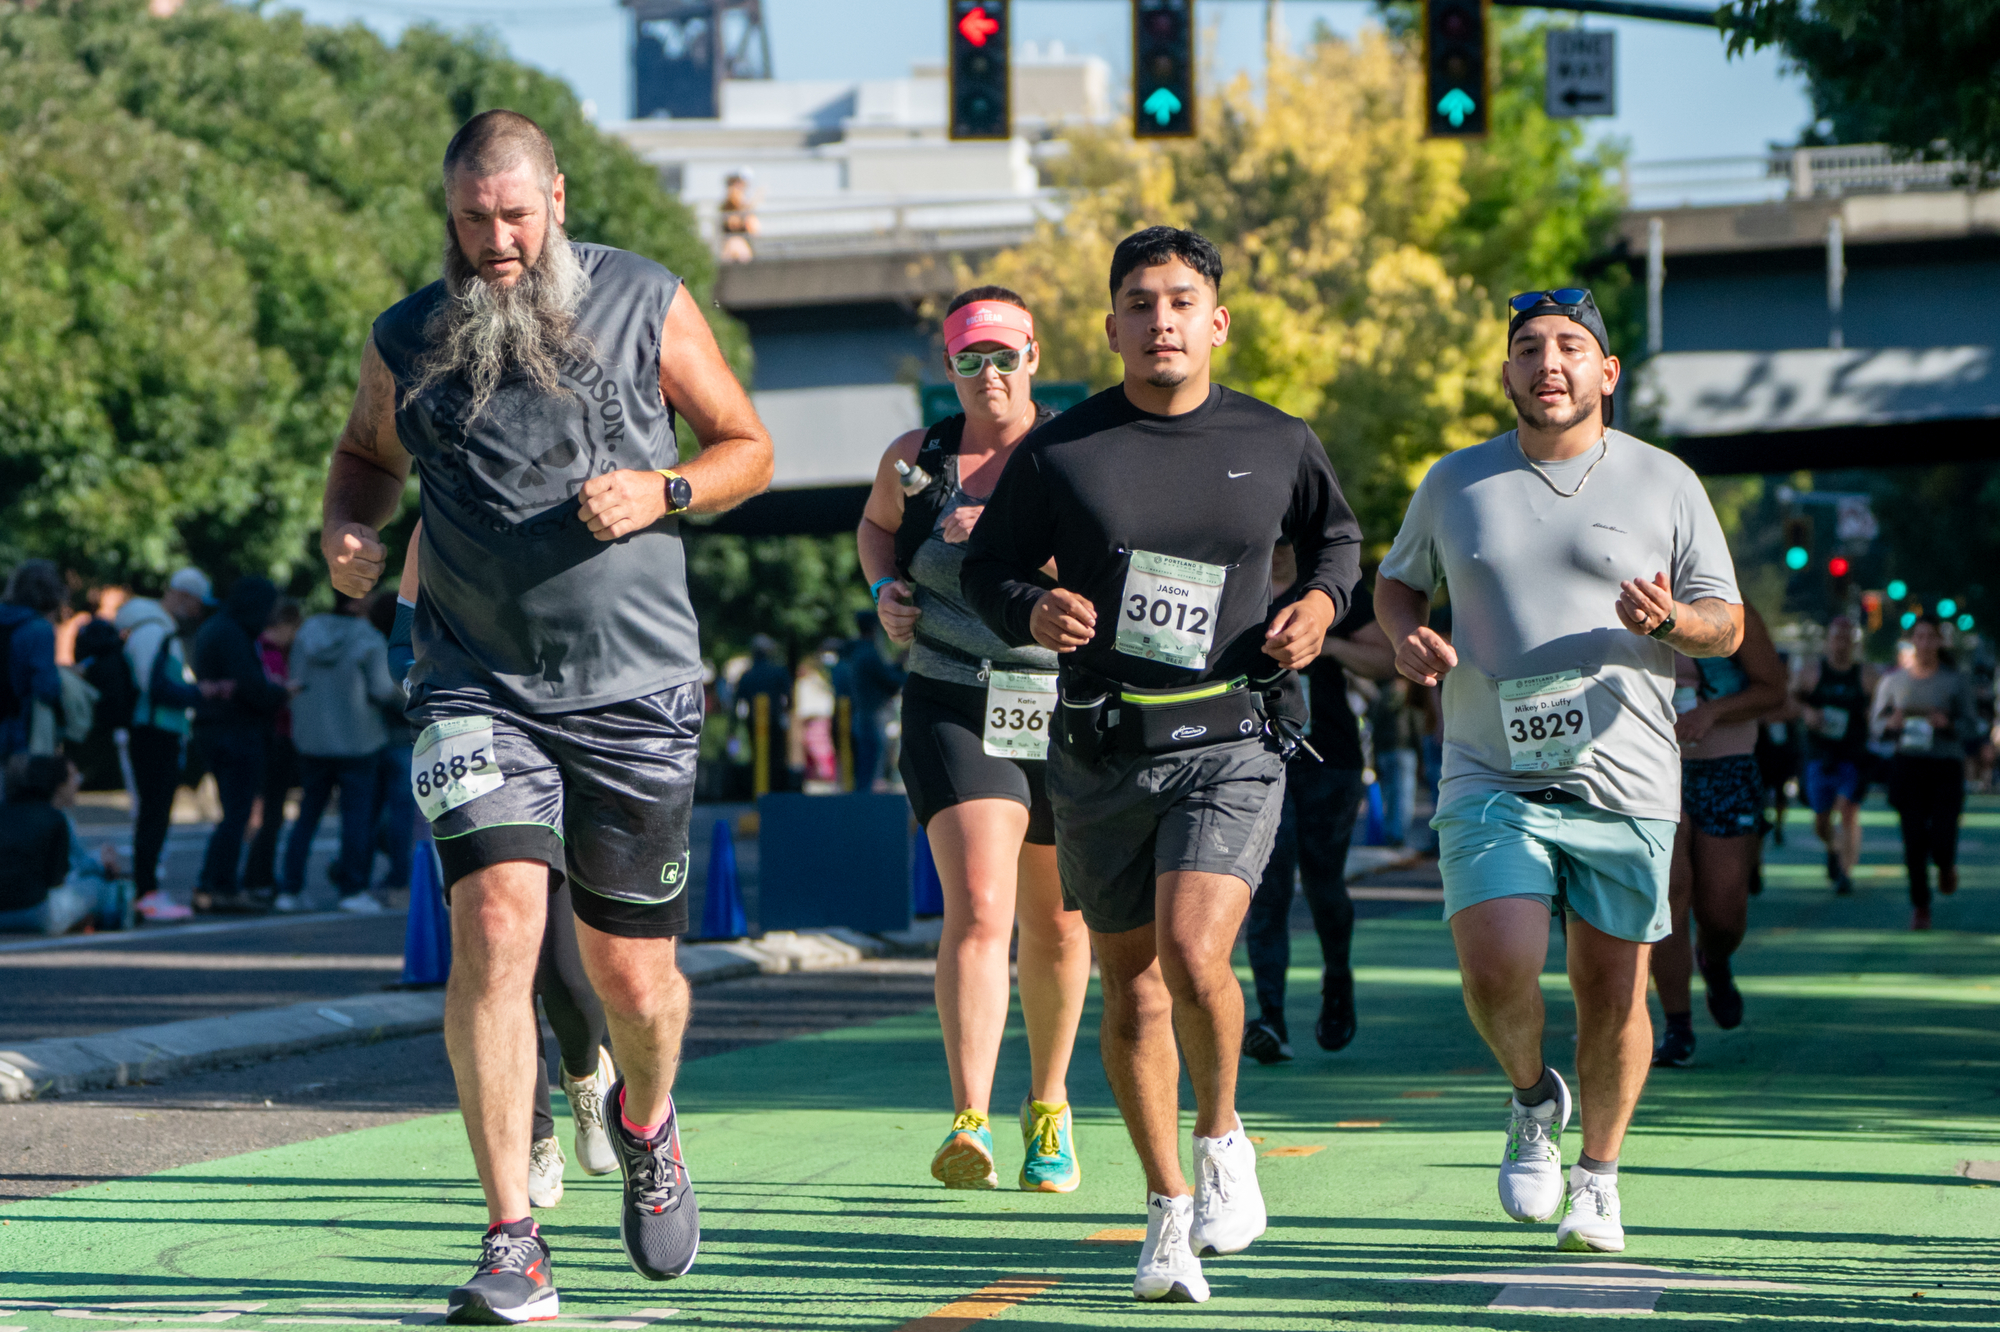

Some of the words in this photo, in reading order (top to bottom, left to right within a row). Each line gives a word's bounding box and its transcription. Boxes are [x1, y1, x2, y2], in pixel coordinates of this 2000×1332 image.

[559, 357, 625, 443] IDSON
[1164, 557, 1197, 568] PORTLAND
[1157, 584, 1189, 597] JASON
[1126, 594, 1209, 635] 3012
[1017, 697, 1037, 705] Katie
[1514, 704, 1539, 713] Mikey
[1551, 698, 1571, 707] Luffy
[1509, 709, 1584, 743] 3829
[416, 747, 488, 797] 8885
